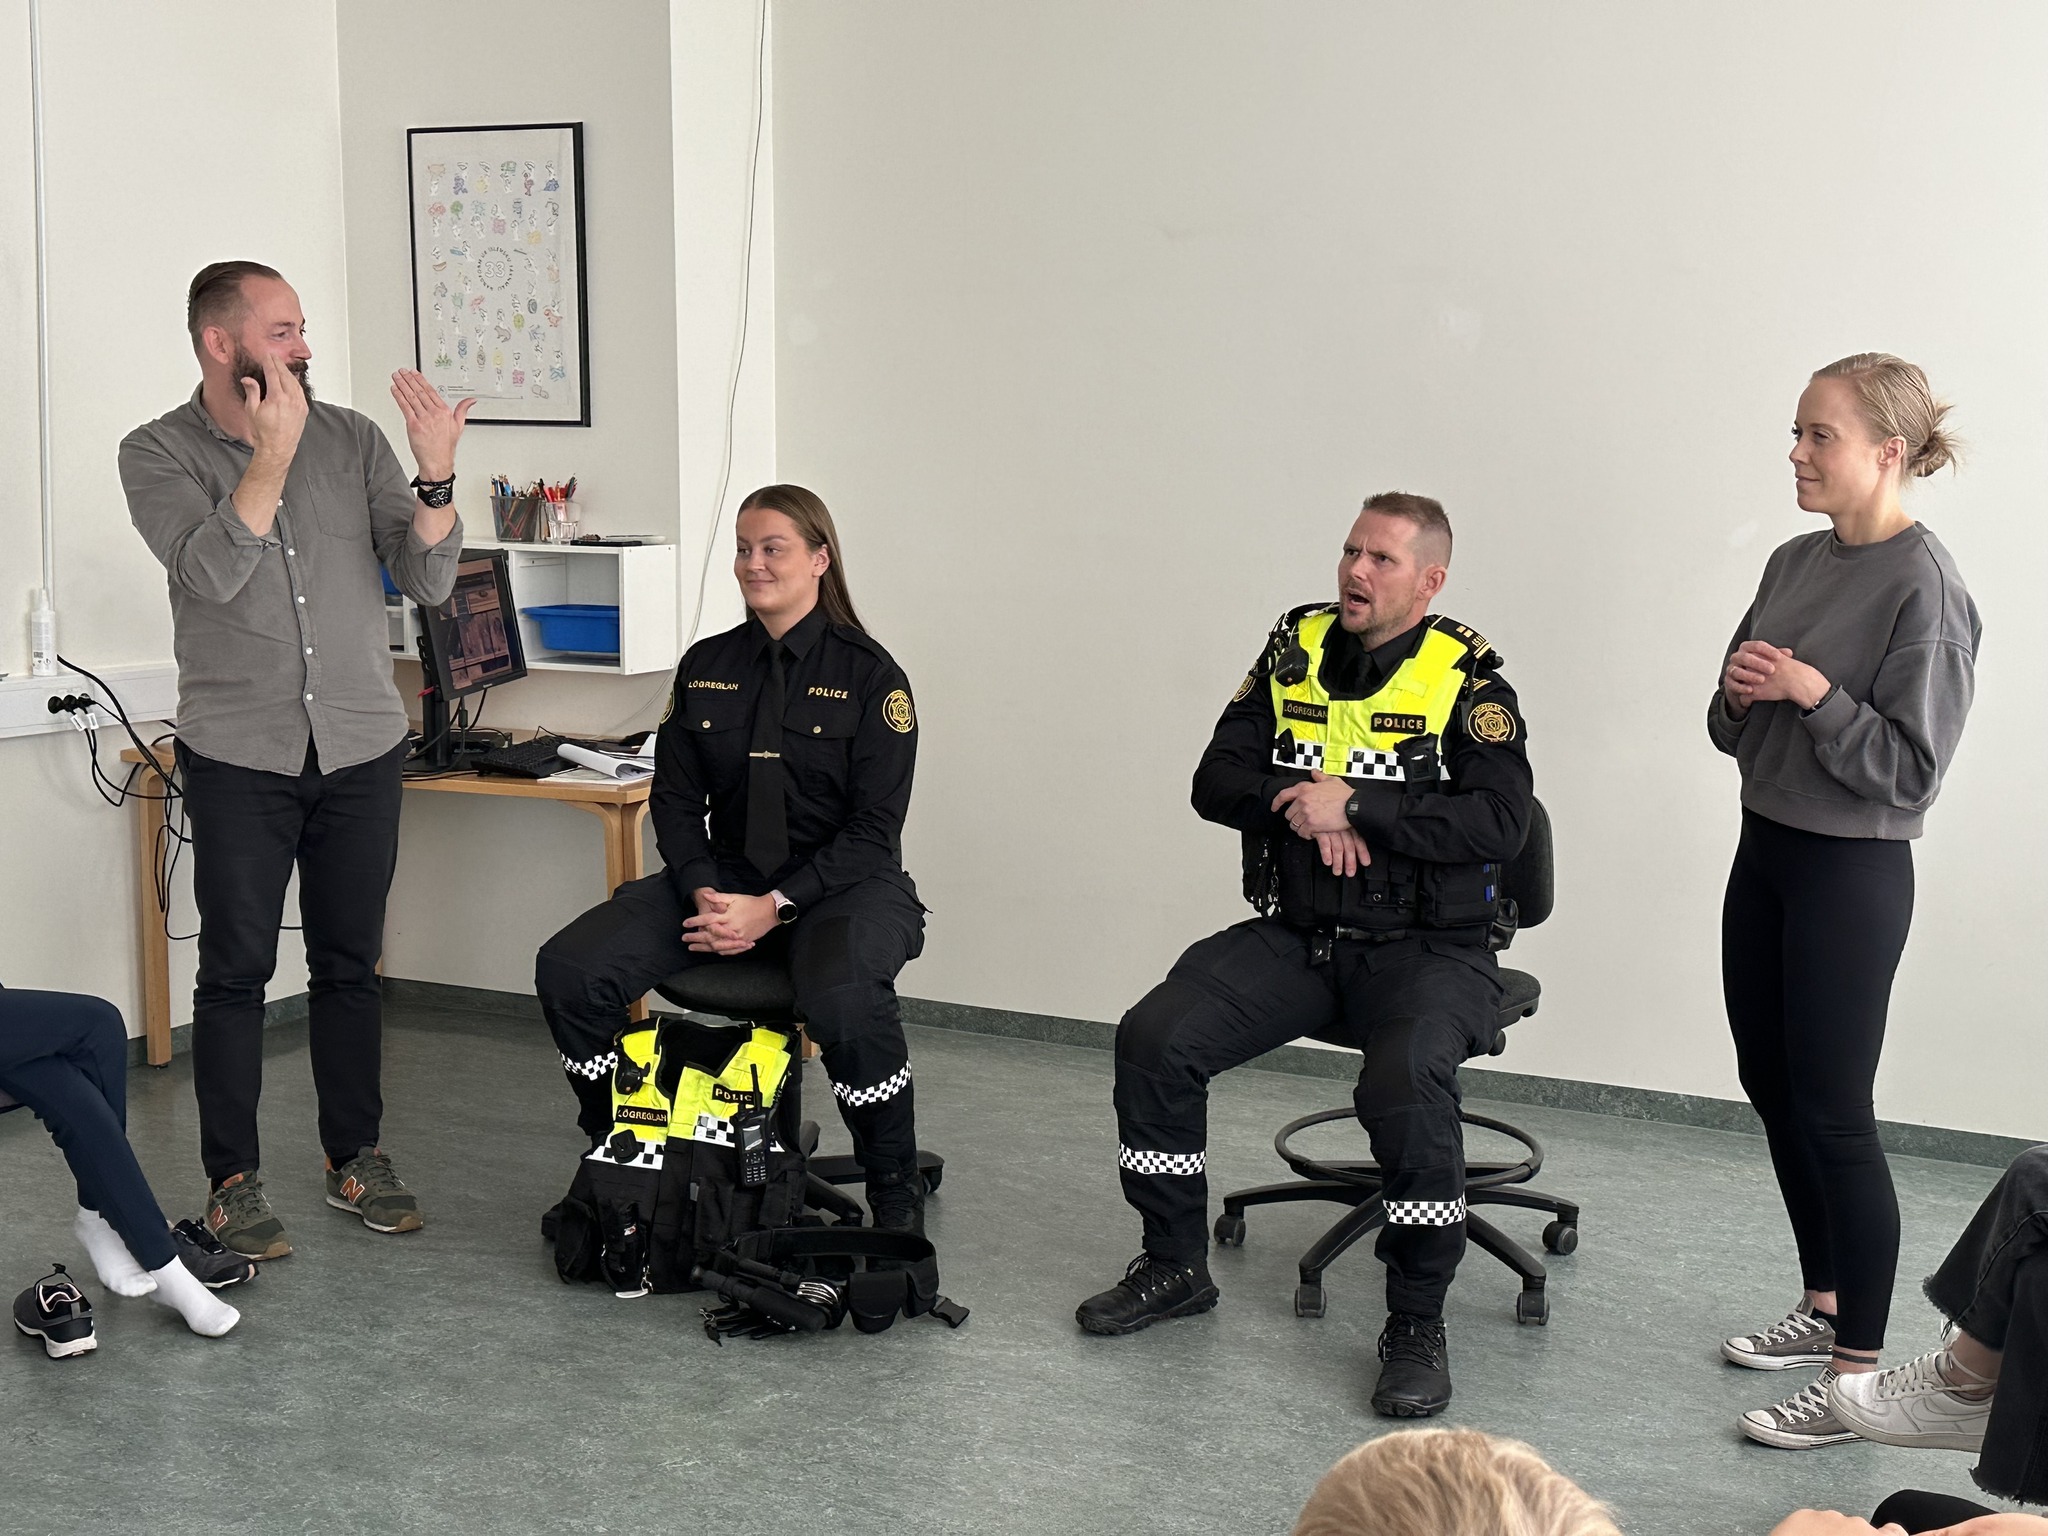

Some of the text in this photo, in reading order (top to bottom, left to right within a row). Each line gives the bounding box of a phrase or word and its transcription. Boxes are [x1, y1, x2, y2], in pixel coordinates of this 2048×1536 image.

[485, 261, 505, 278] 33
[808, 687, 848, 699] POLICE
[1373, 717, 1424, 730] POLICE
[715, 1087, 753, 1102] POLIC
[340, 1175, 365, 1205] N
[208, 1204, 228, 1232] N
